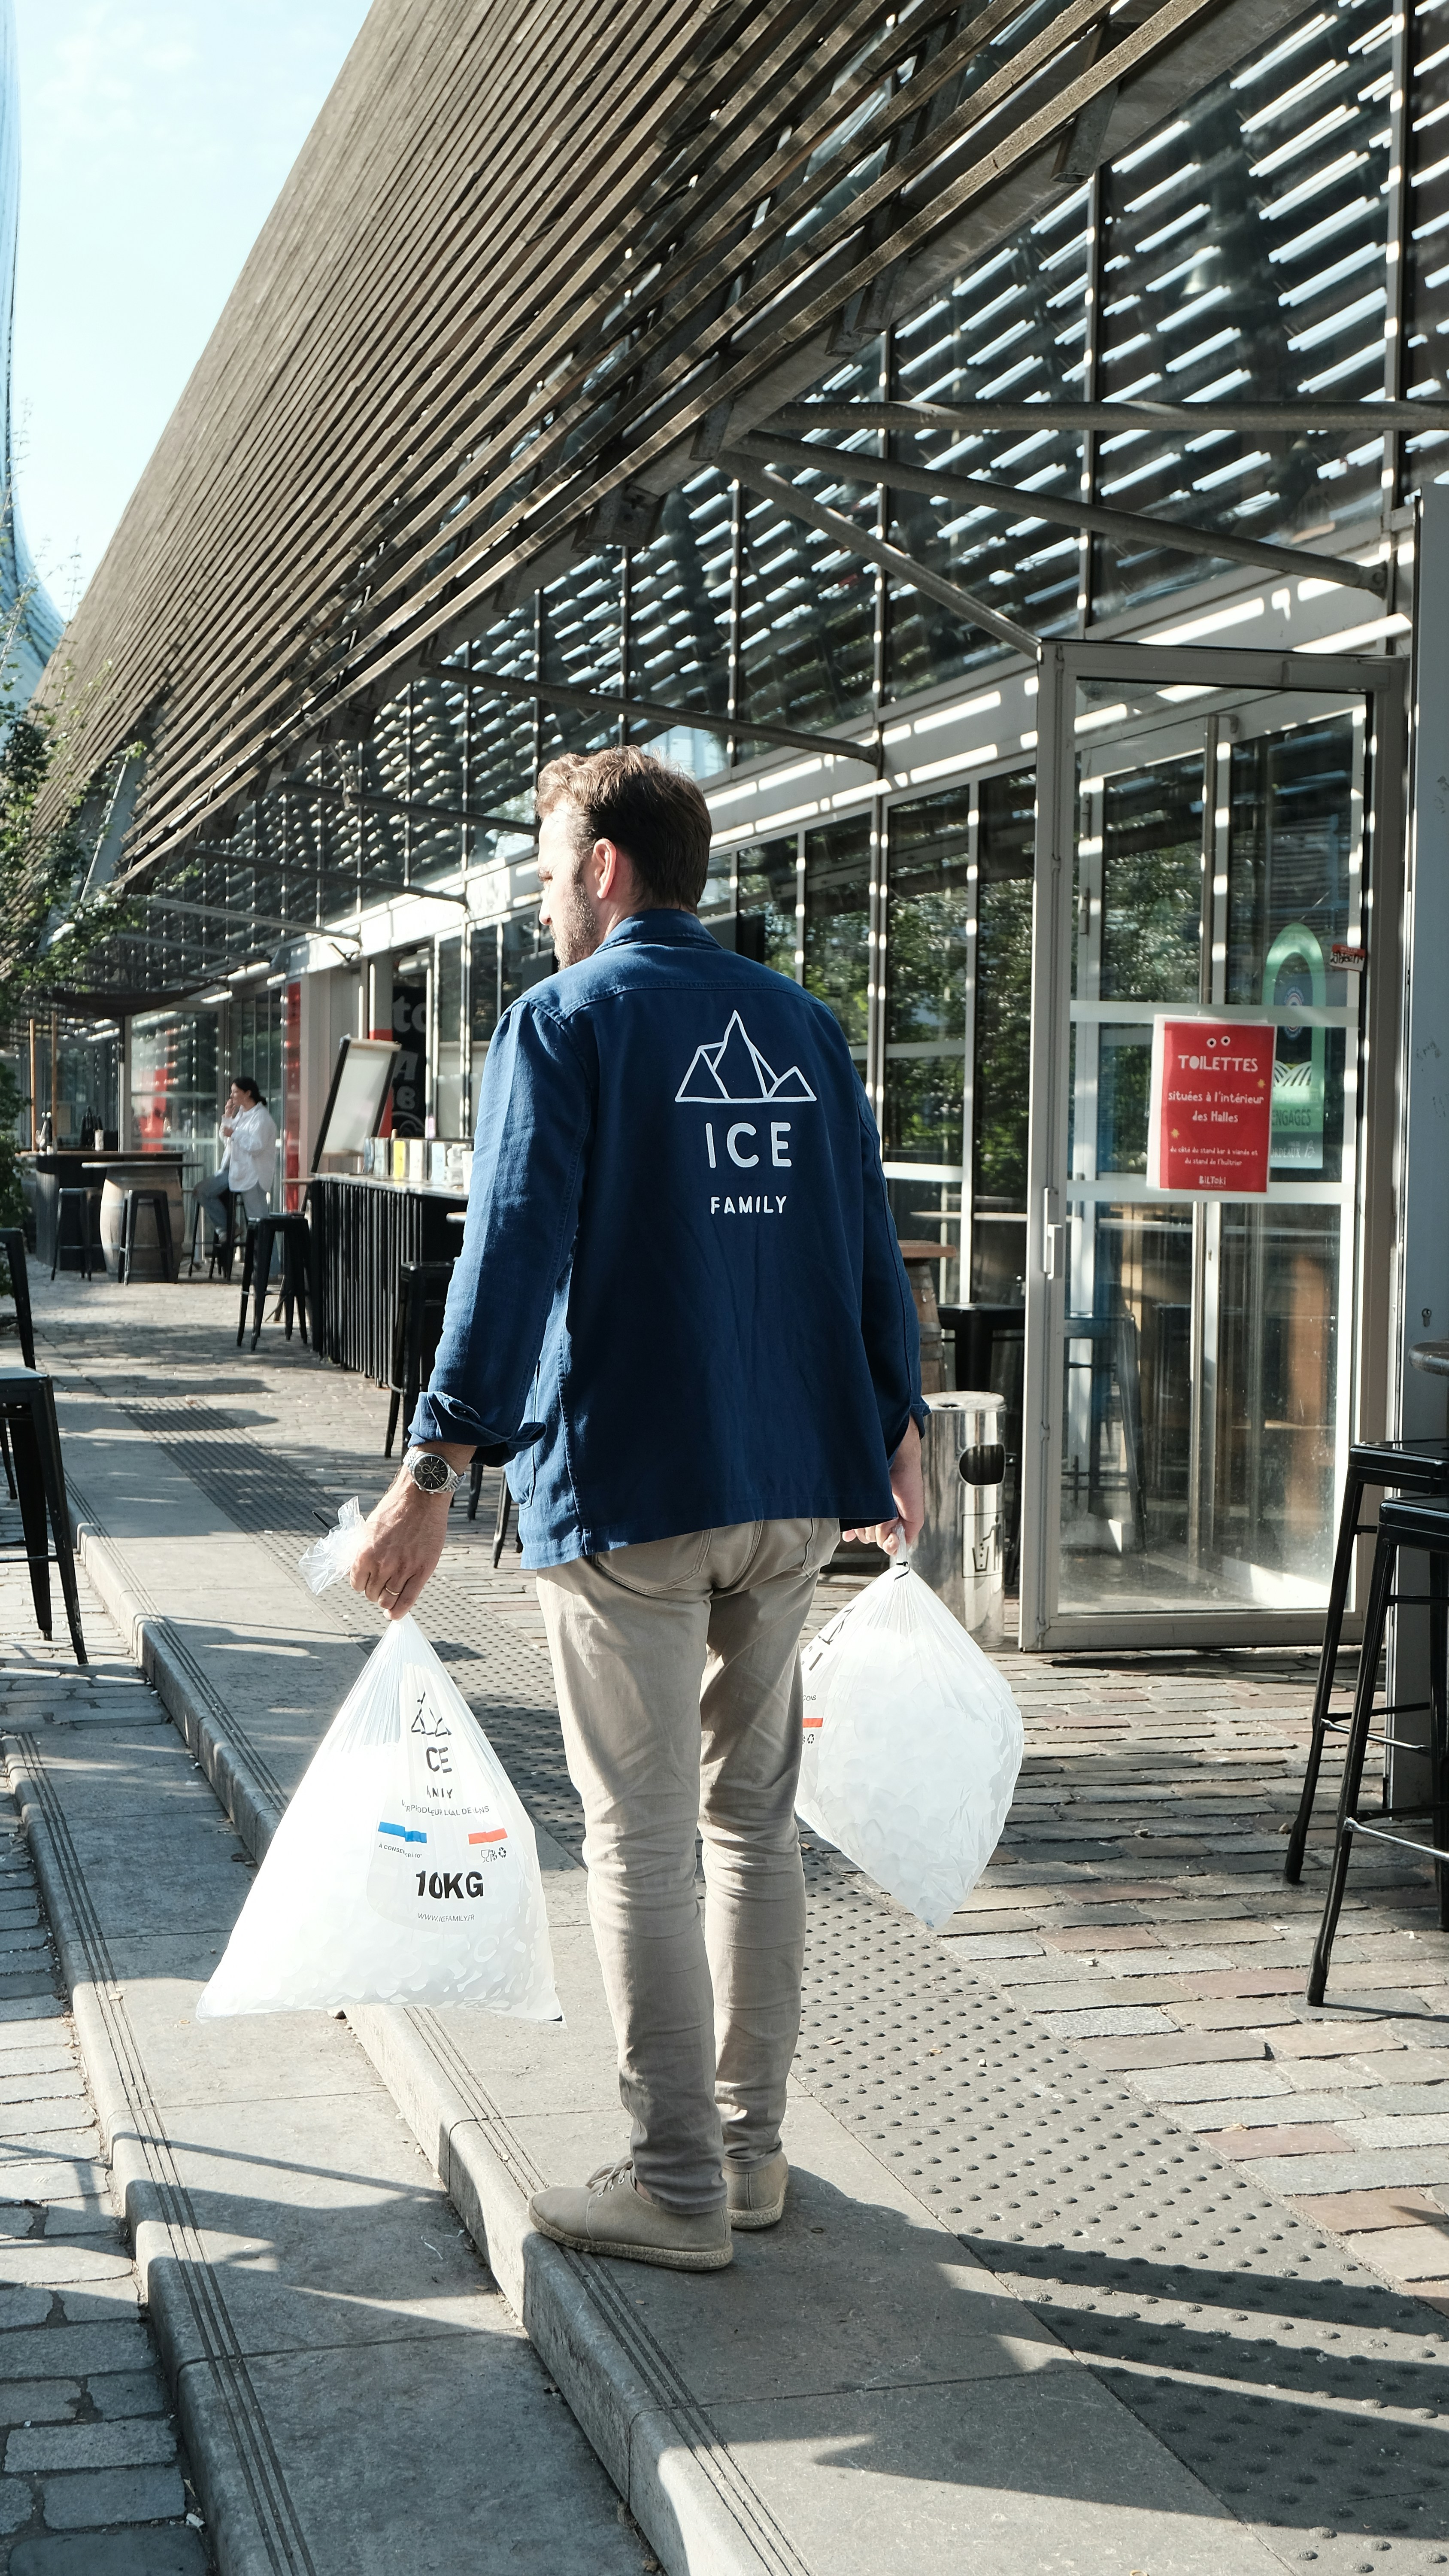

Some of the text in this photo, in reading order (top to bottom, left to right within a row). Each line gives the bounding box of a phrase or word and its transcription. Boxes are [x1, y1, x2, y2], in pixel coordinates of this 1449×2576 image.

[1178, 1055, 1258, 1072] TOILETTES
[1168, 1091, 1203, 1102] situées
[1206, 1091, 1211, 1102] à
[1215, 1091, 1264, 1104] l'intérieur
[1192, 1110, 1239, 1123] des Halles
[705, 1122, 792, 1168] ICE
[711, 1196, 787, 1214] FAMILY
[415, 1870, 484, 1899] 10KG
[418, 1912, 475, 1923] WWW.ICEFAMILY.FR
